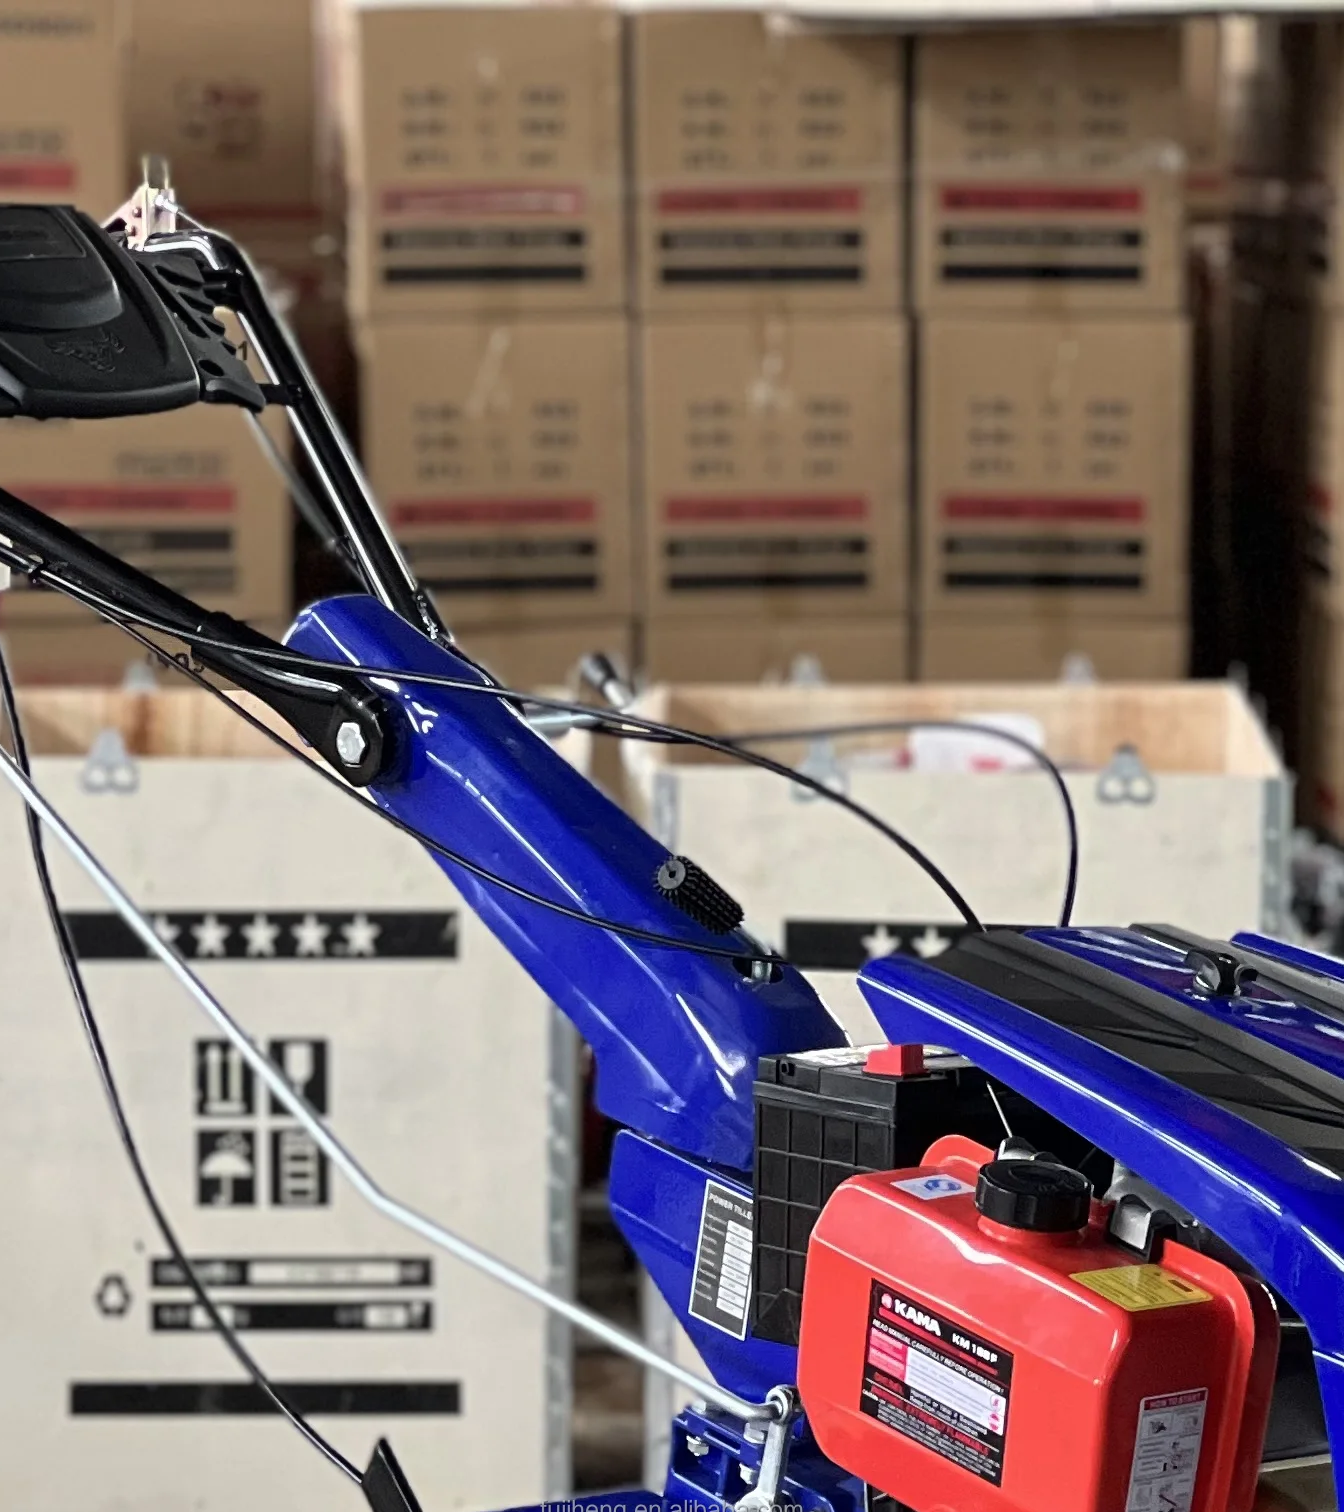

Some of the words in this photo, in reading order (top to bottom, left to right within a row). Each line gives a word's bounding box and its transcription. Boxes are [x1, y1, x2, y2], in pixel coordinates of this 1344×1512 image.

[709, 1192, 733, 1210] POWER
[733, 1204, 753, 1220] TILLE
[894, 1298, 941, 1336] KAMA
